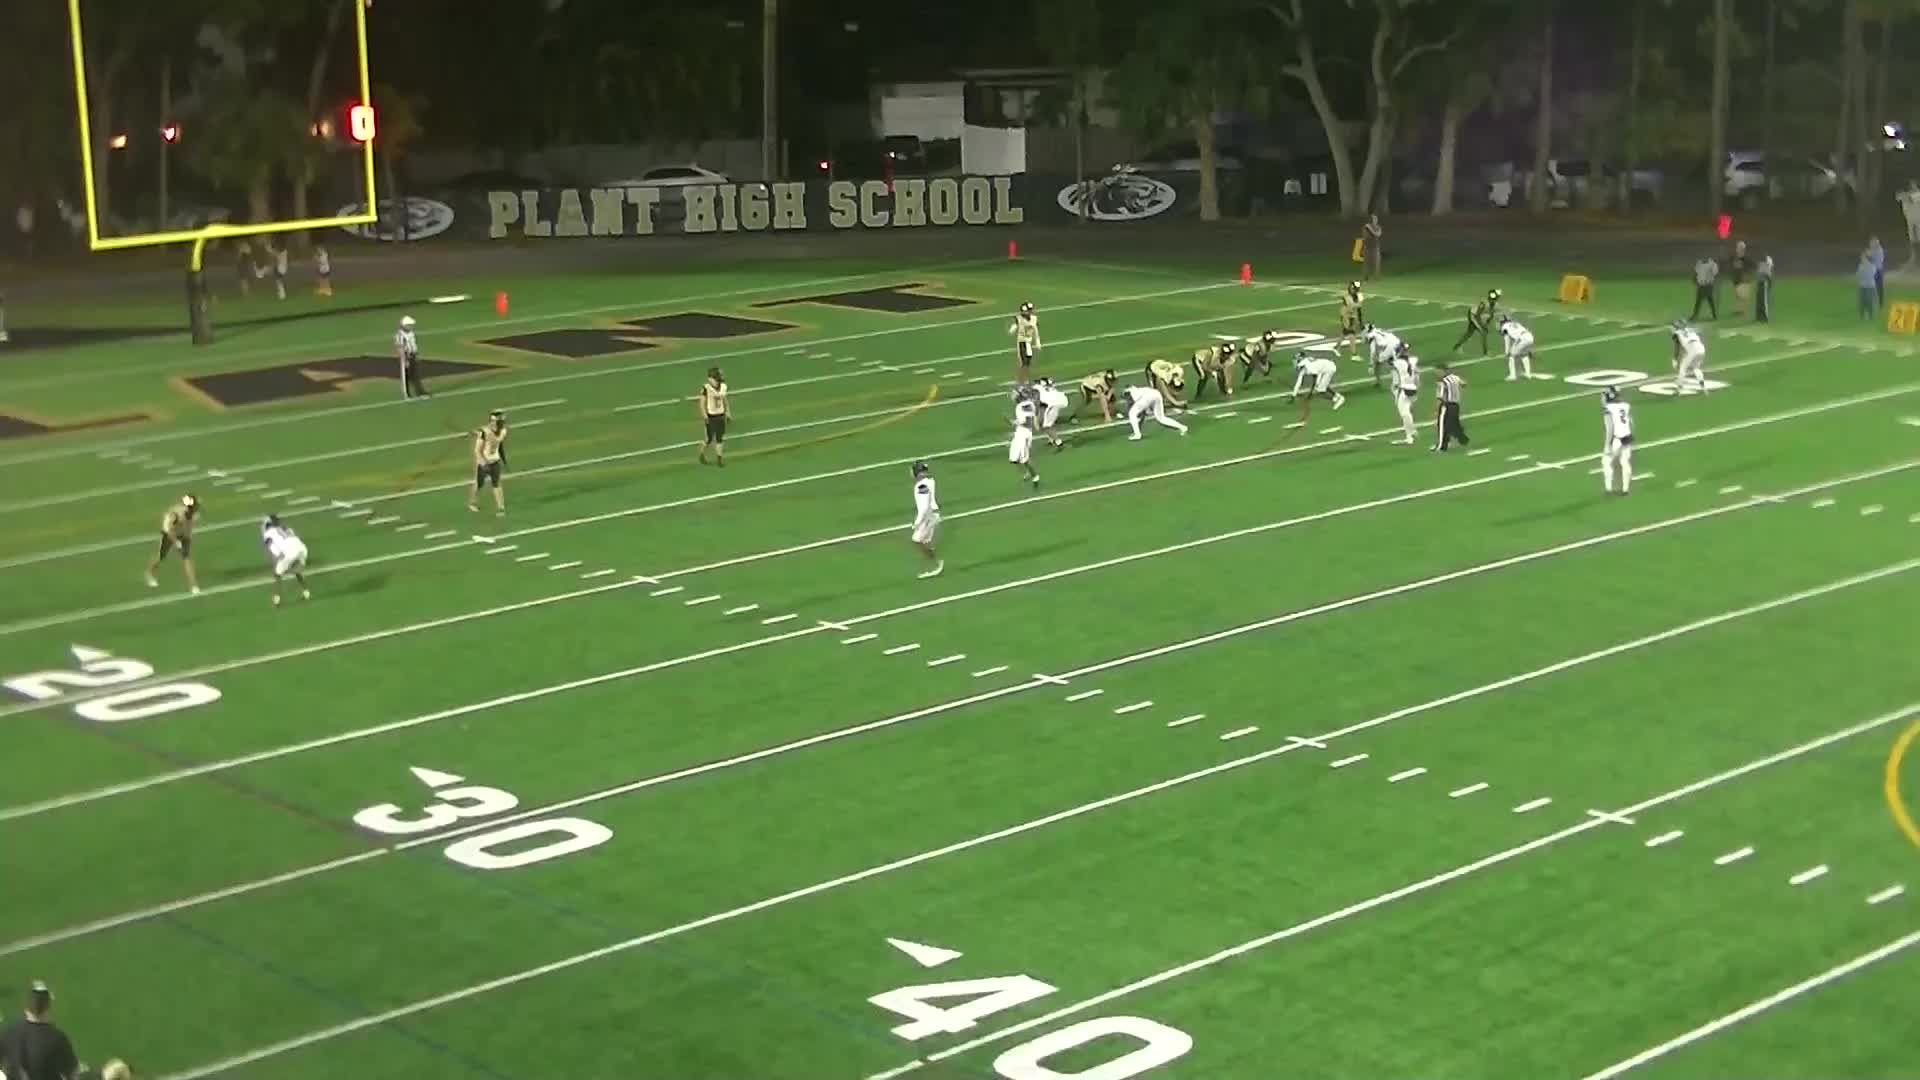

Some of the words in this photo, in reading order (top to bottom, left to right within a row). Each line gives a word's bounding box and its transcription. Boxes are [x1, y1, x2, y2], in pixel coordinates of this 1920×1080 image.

[488, 187, 660, 239] PLANT
[682, 182, 807, 233] HIGH
[829, 177, 1023, 228] SCHOOL
[1, 657, 222, 721] 20
[352, 786, 614, 870] 30
[866, 974, 1194, 1080] 40
